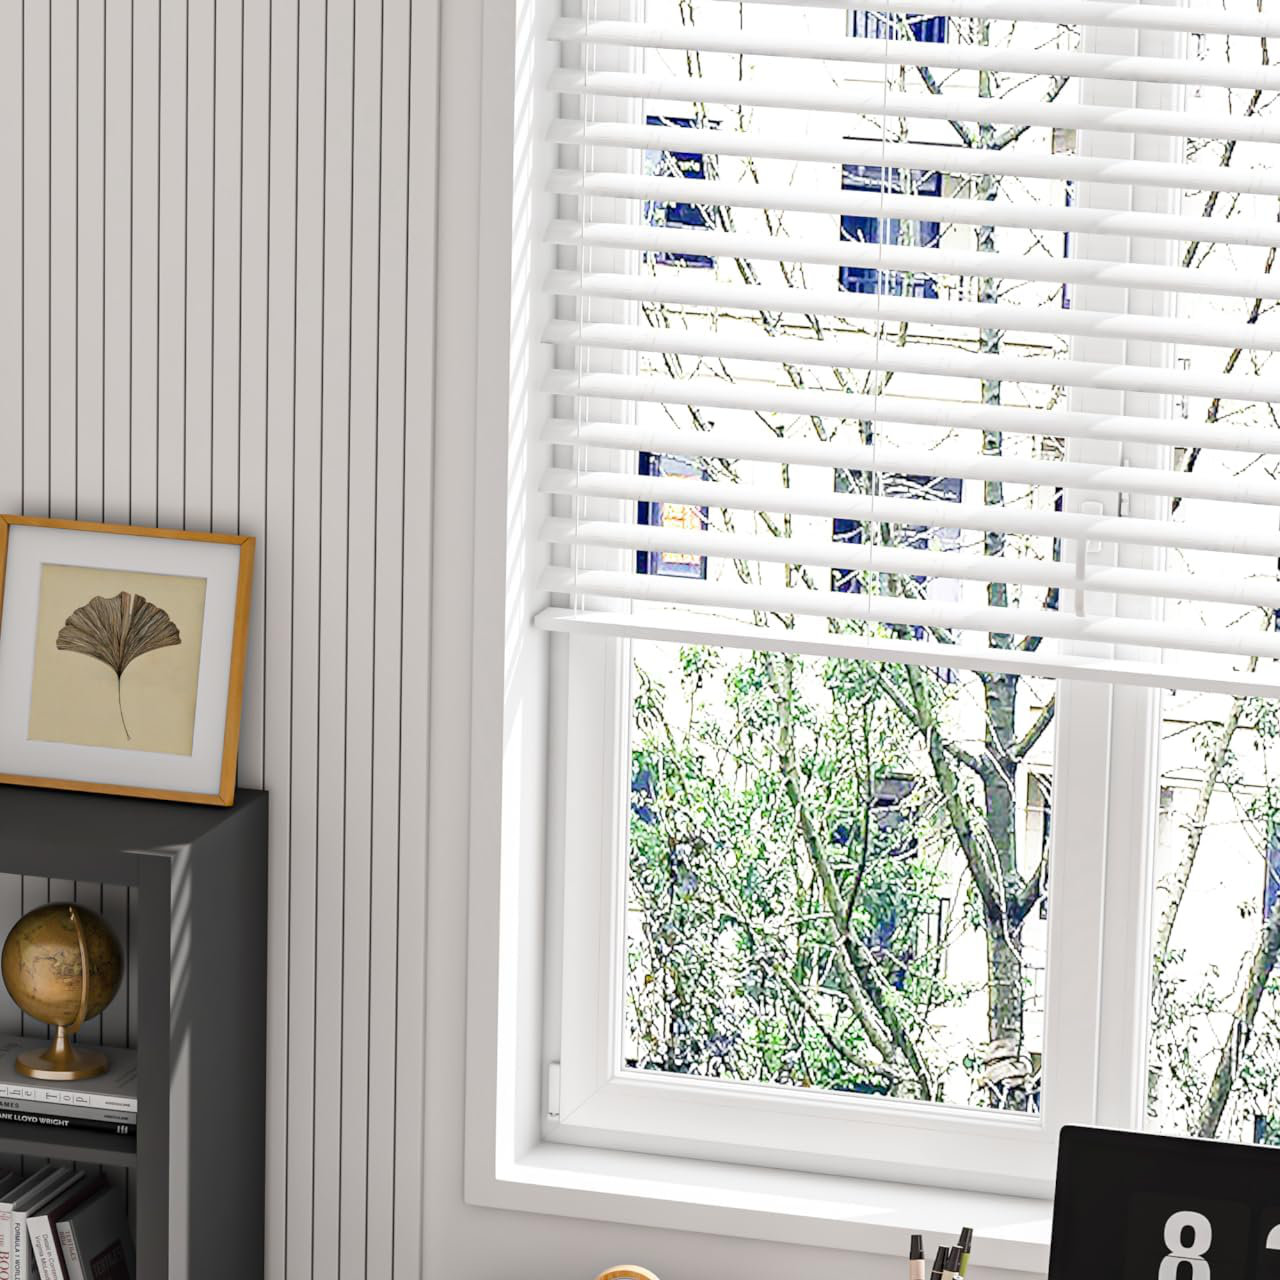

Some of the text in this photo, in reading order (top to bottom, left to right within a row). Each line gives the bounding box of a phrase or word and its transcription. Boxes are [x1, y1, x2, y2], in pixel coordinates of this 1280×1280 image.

[14, 1114, 38, 1123] LLOYD
[39, 1117, 70, 1127] WRIGHT
[34, 1235, 44, 1257] Virginia
[42, 1234, 52, 1251] Detail
